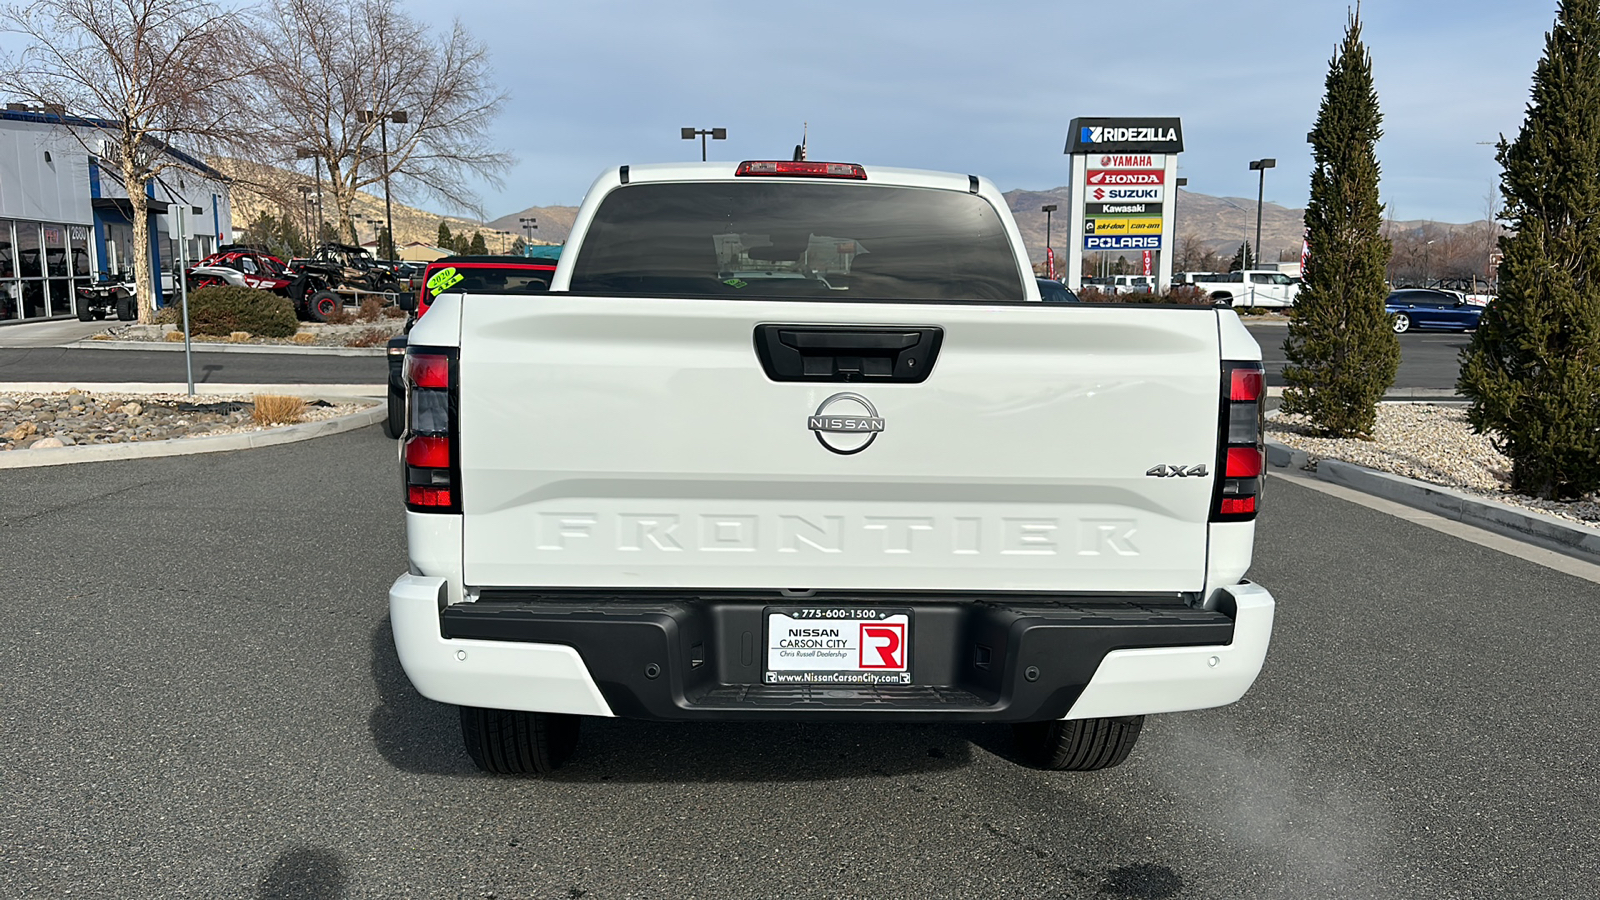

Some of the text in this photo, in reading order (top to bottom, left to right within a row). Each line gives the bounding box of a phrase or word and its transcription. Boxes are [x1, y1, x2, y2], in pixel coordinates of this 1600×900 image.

[1103, 127, 1177, 142] RIDEZILLA
[1112, 156, 1152, 167] YAMAHA
[1104, 174, 1160, 183] HONDA
[1109, 189, 1157, 198] SUZUKI
[1102, 204, 1145, 213] Kawasaki
[1087, 237, 1159, 248] POLARIS
[432, 269, 451, 286] 2020
[811, 418, 883, 430] NISSAN
[535, 511, 1140, 556] FRONTIER
[802, 609, 876, 619] 775-600-1500
[788, 629, 839, 637] NISSAN
[779, 639, 848, 648] CARSON CITY
[779, 650, 848, 659] Chris Russell Dealership
[778, 672, 899, 684] www.NissanCarsonCity.com
